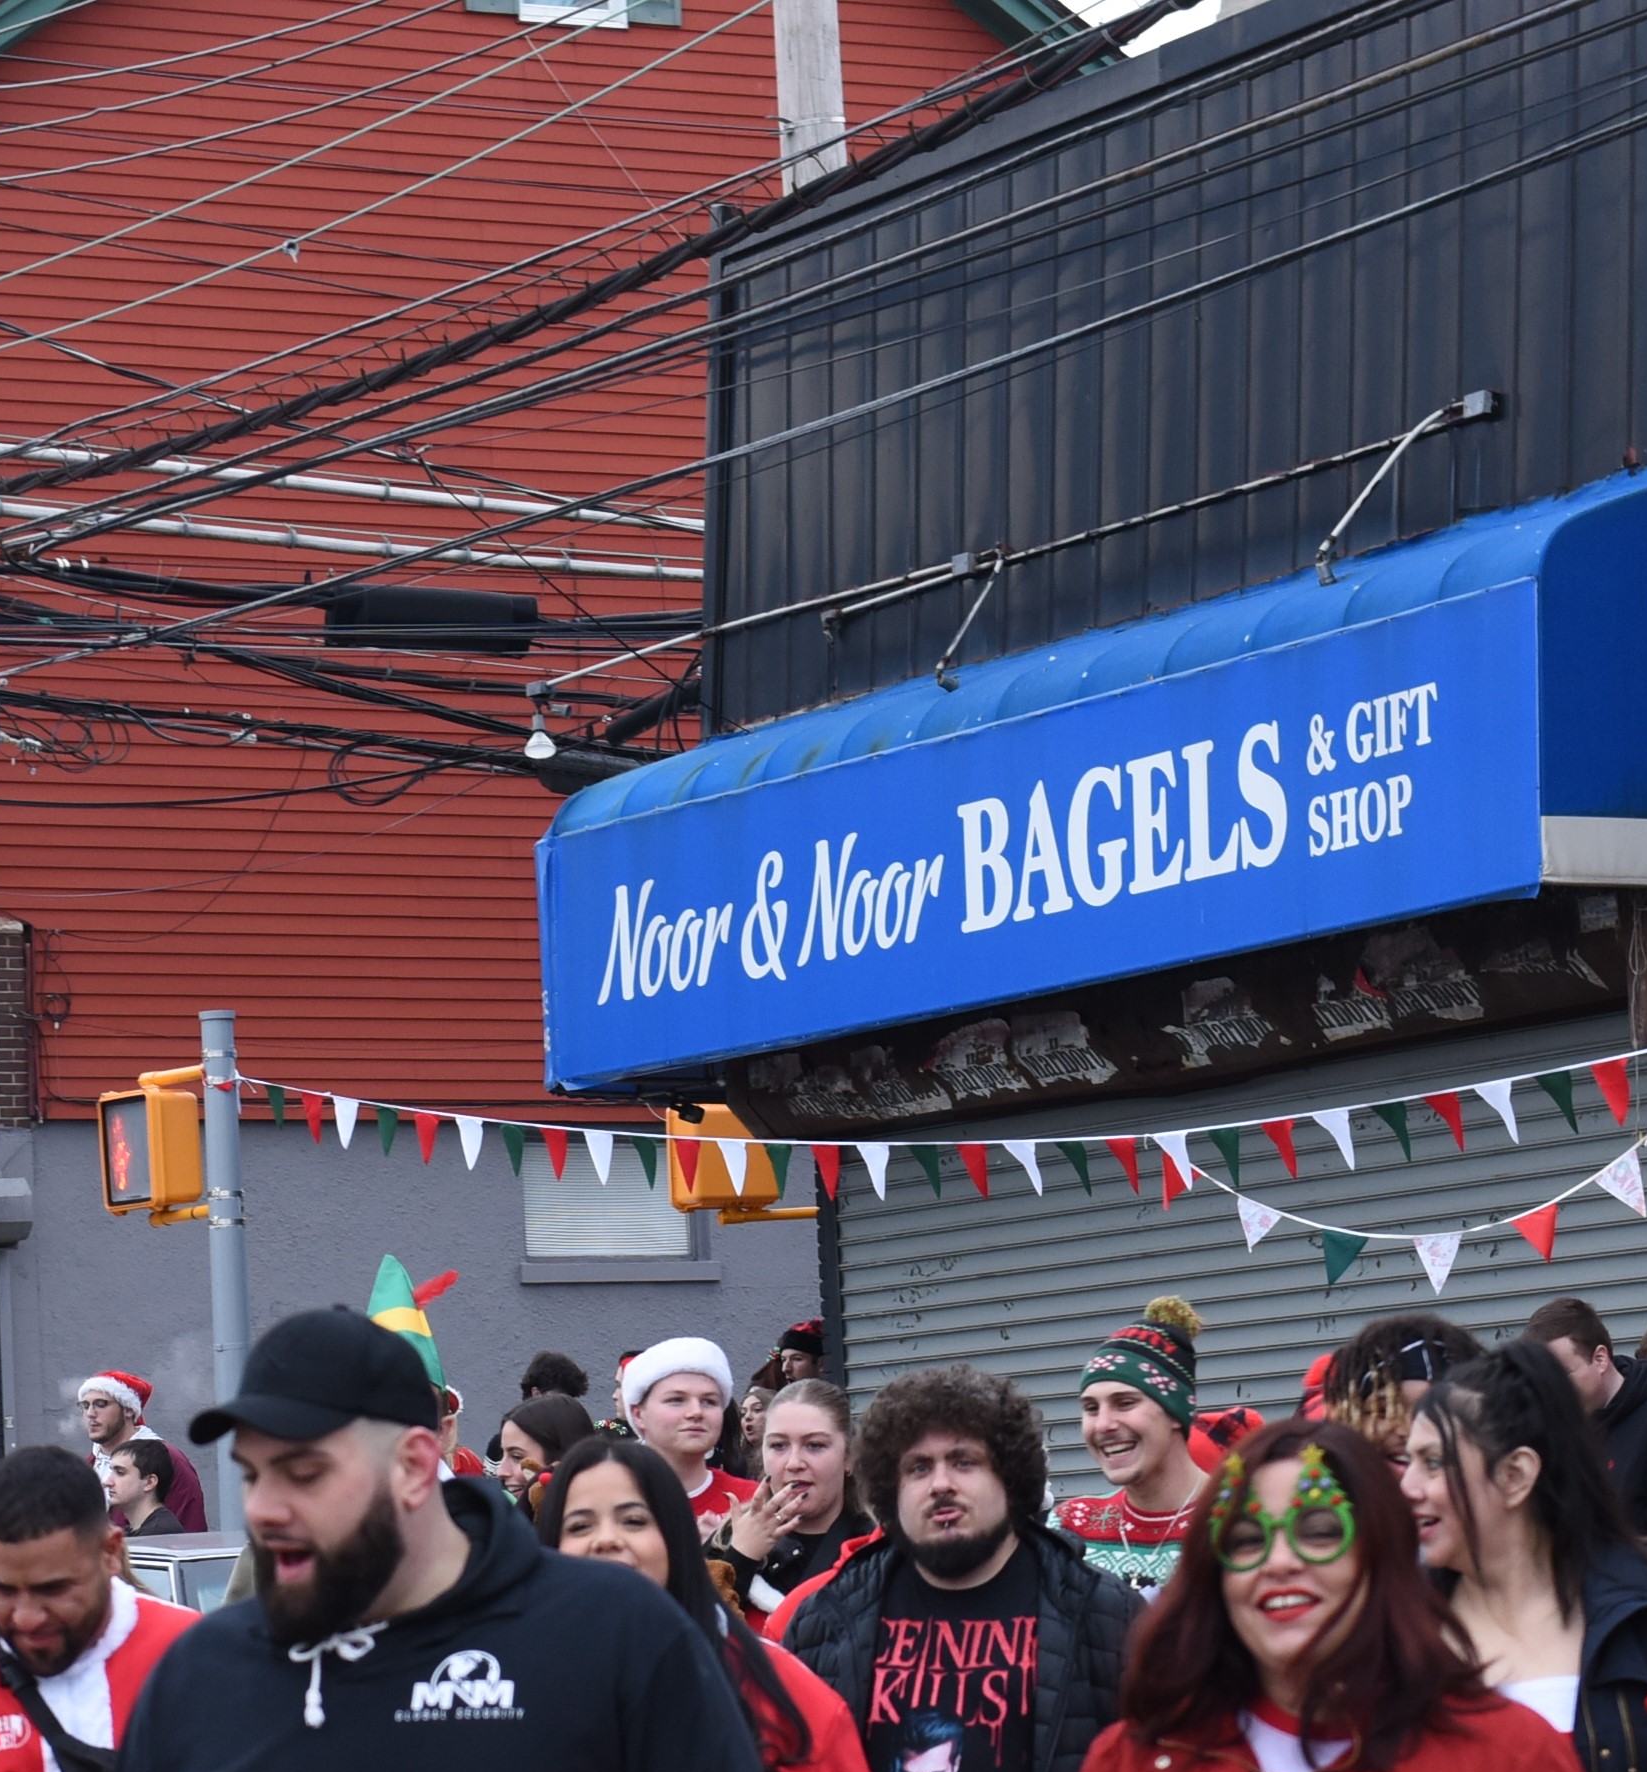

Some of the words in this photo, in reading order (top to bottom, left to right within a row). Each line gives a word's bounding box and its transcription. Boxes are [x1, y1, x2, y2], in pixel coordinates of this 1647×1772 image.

[1306, 713, 1337, 776] &
[1345, 681, 1438, 764] GIFT
[1308, 773, 1413, 858] SHOP
[598, 879, 733, 1006] Noor
[740, 851, 788, 981] &
[796, 832, 944, 967] Noor
[957, 720, 1288, 934] BAGELS
[455, 1706, 526, 1720] SECURITY
